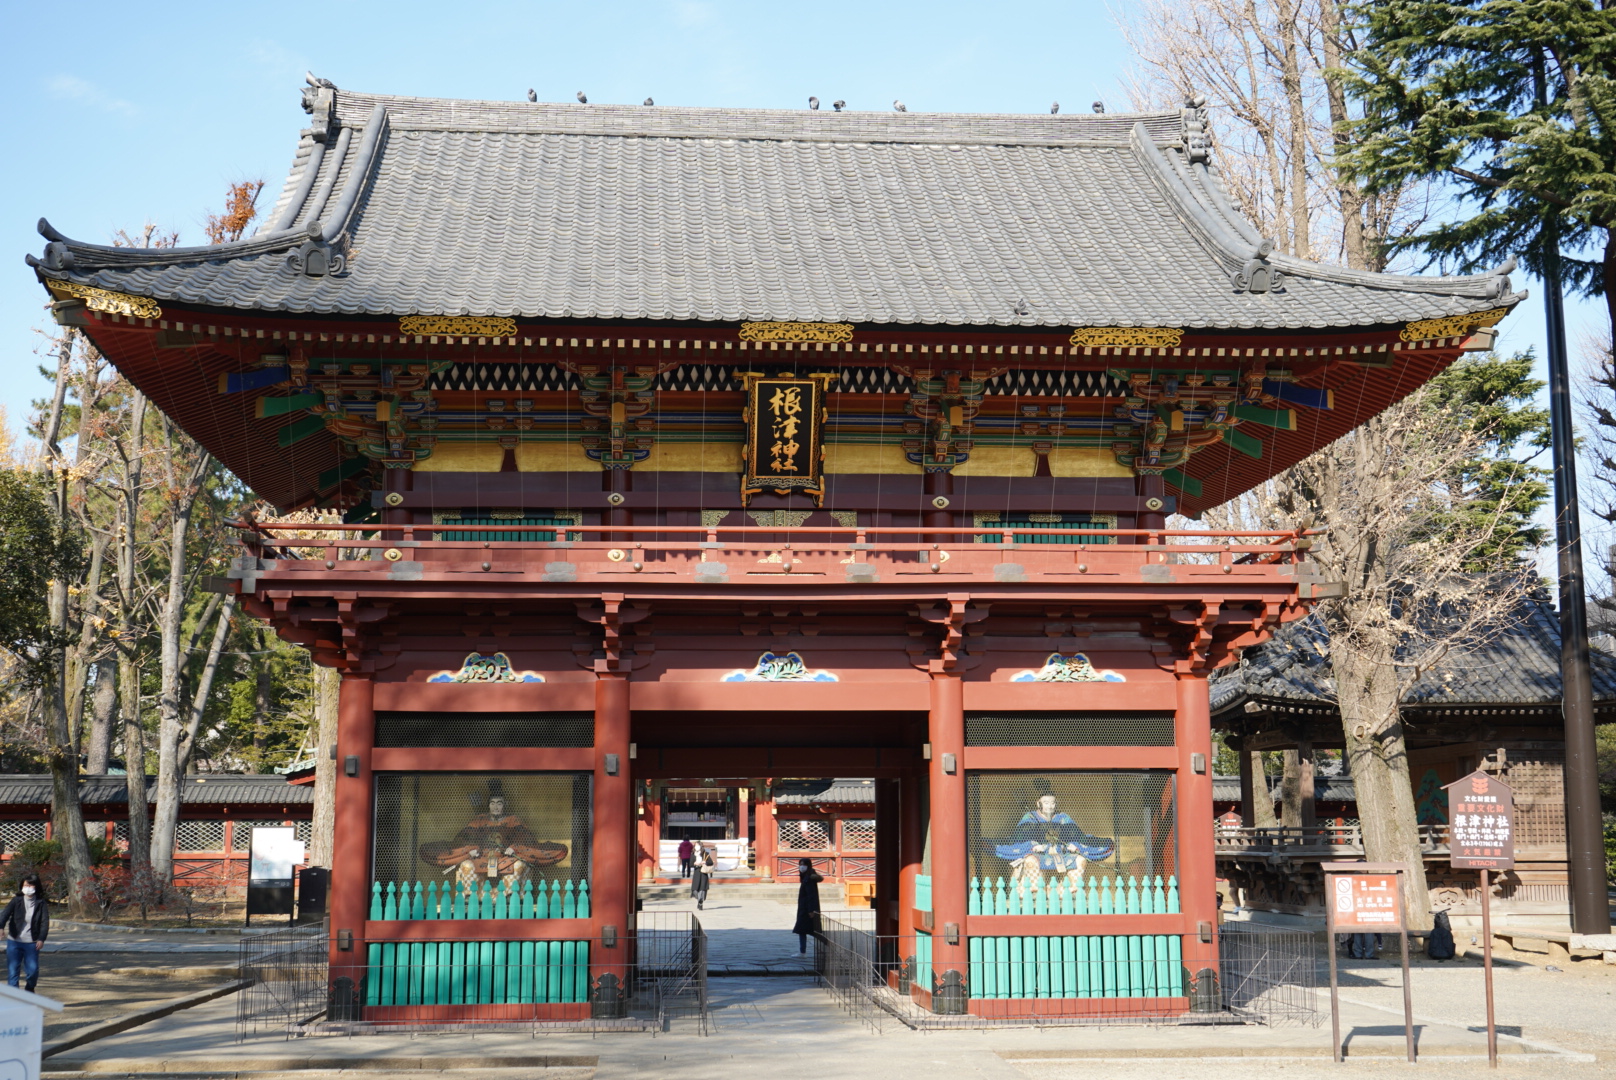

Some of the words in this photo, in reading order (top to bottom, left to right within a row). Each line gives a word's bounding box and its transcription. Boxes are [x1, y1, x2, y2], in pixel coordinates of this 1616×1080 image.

[768, 387, 802, 473] 根津神社
[1457, 803, 1505, 813] 重要文化財
[1454, 814, 1509, 828] 根津神社
